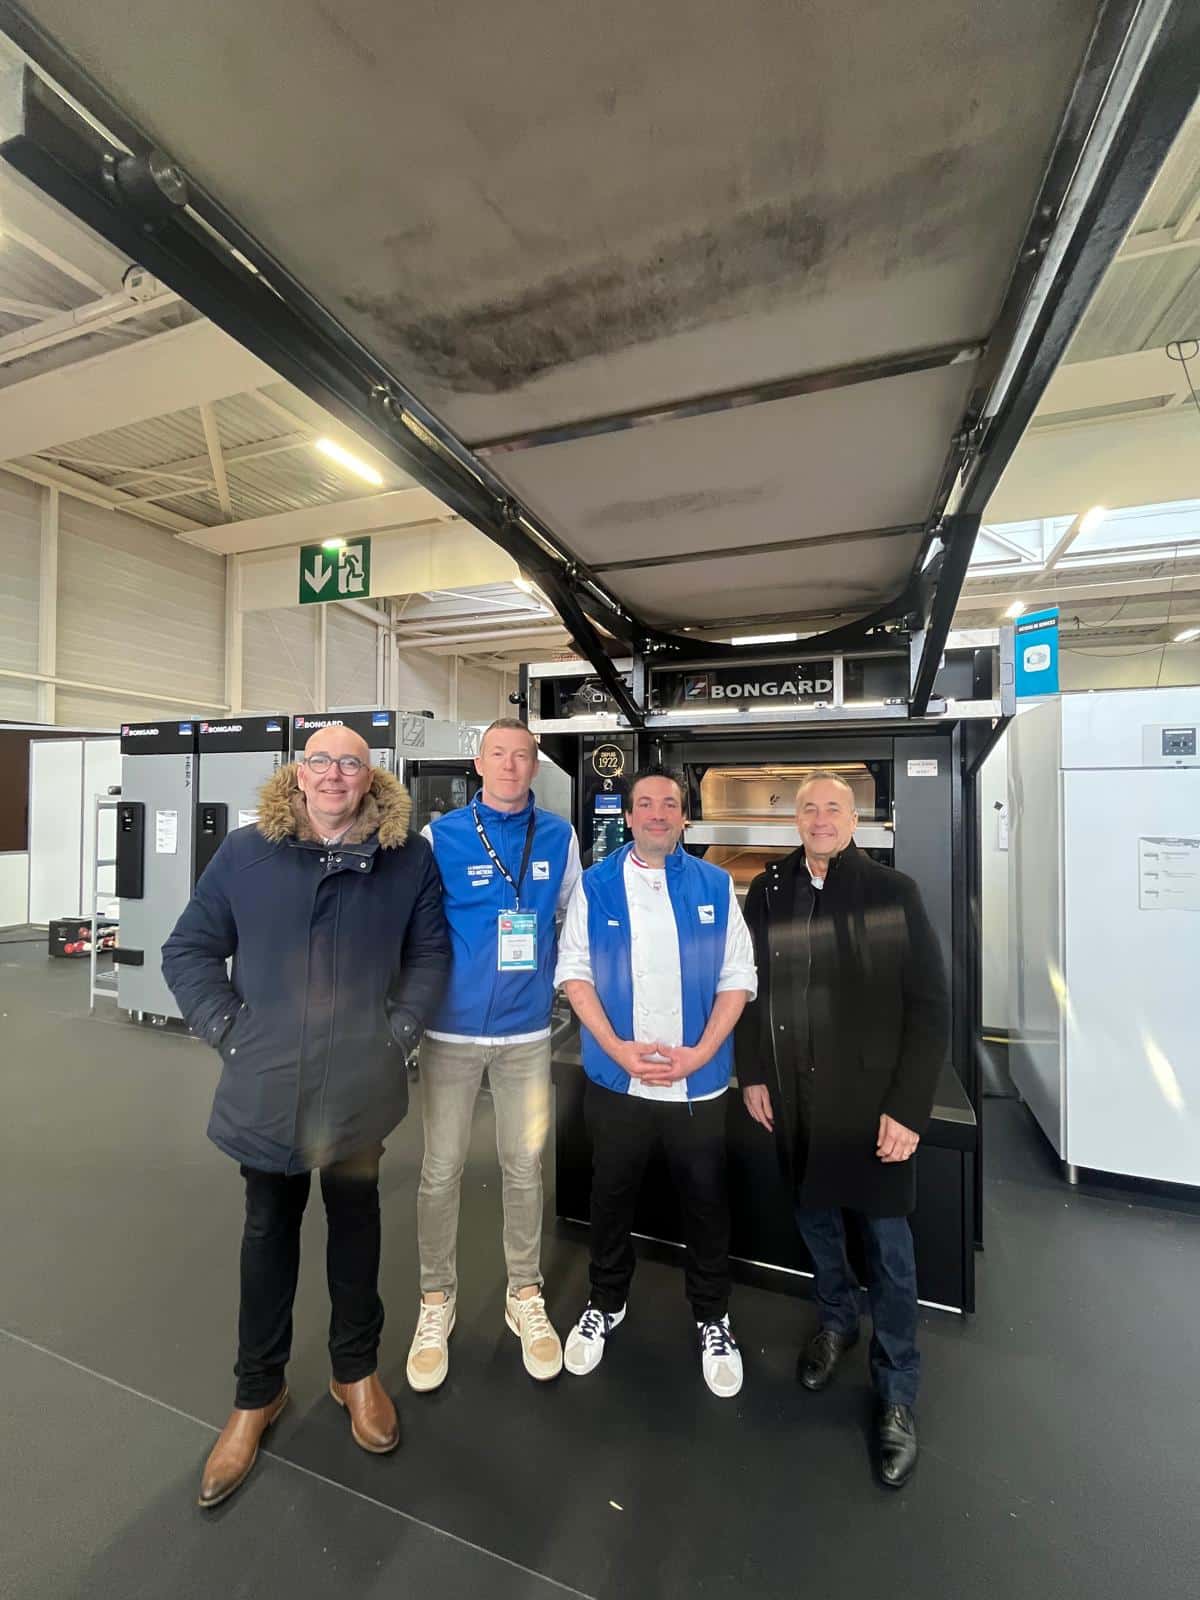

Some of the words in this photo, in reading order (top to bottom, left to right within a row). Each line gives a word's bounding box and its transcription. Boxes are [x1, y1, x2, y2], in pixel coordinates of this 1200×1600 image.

[711, 679, 833, 699] BONGARD
[129, 728, 159, 736] BONGARD
[208, 725, 242, 734] BONGARD
[599, 757, 618, 768] 1922
